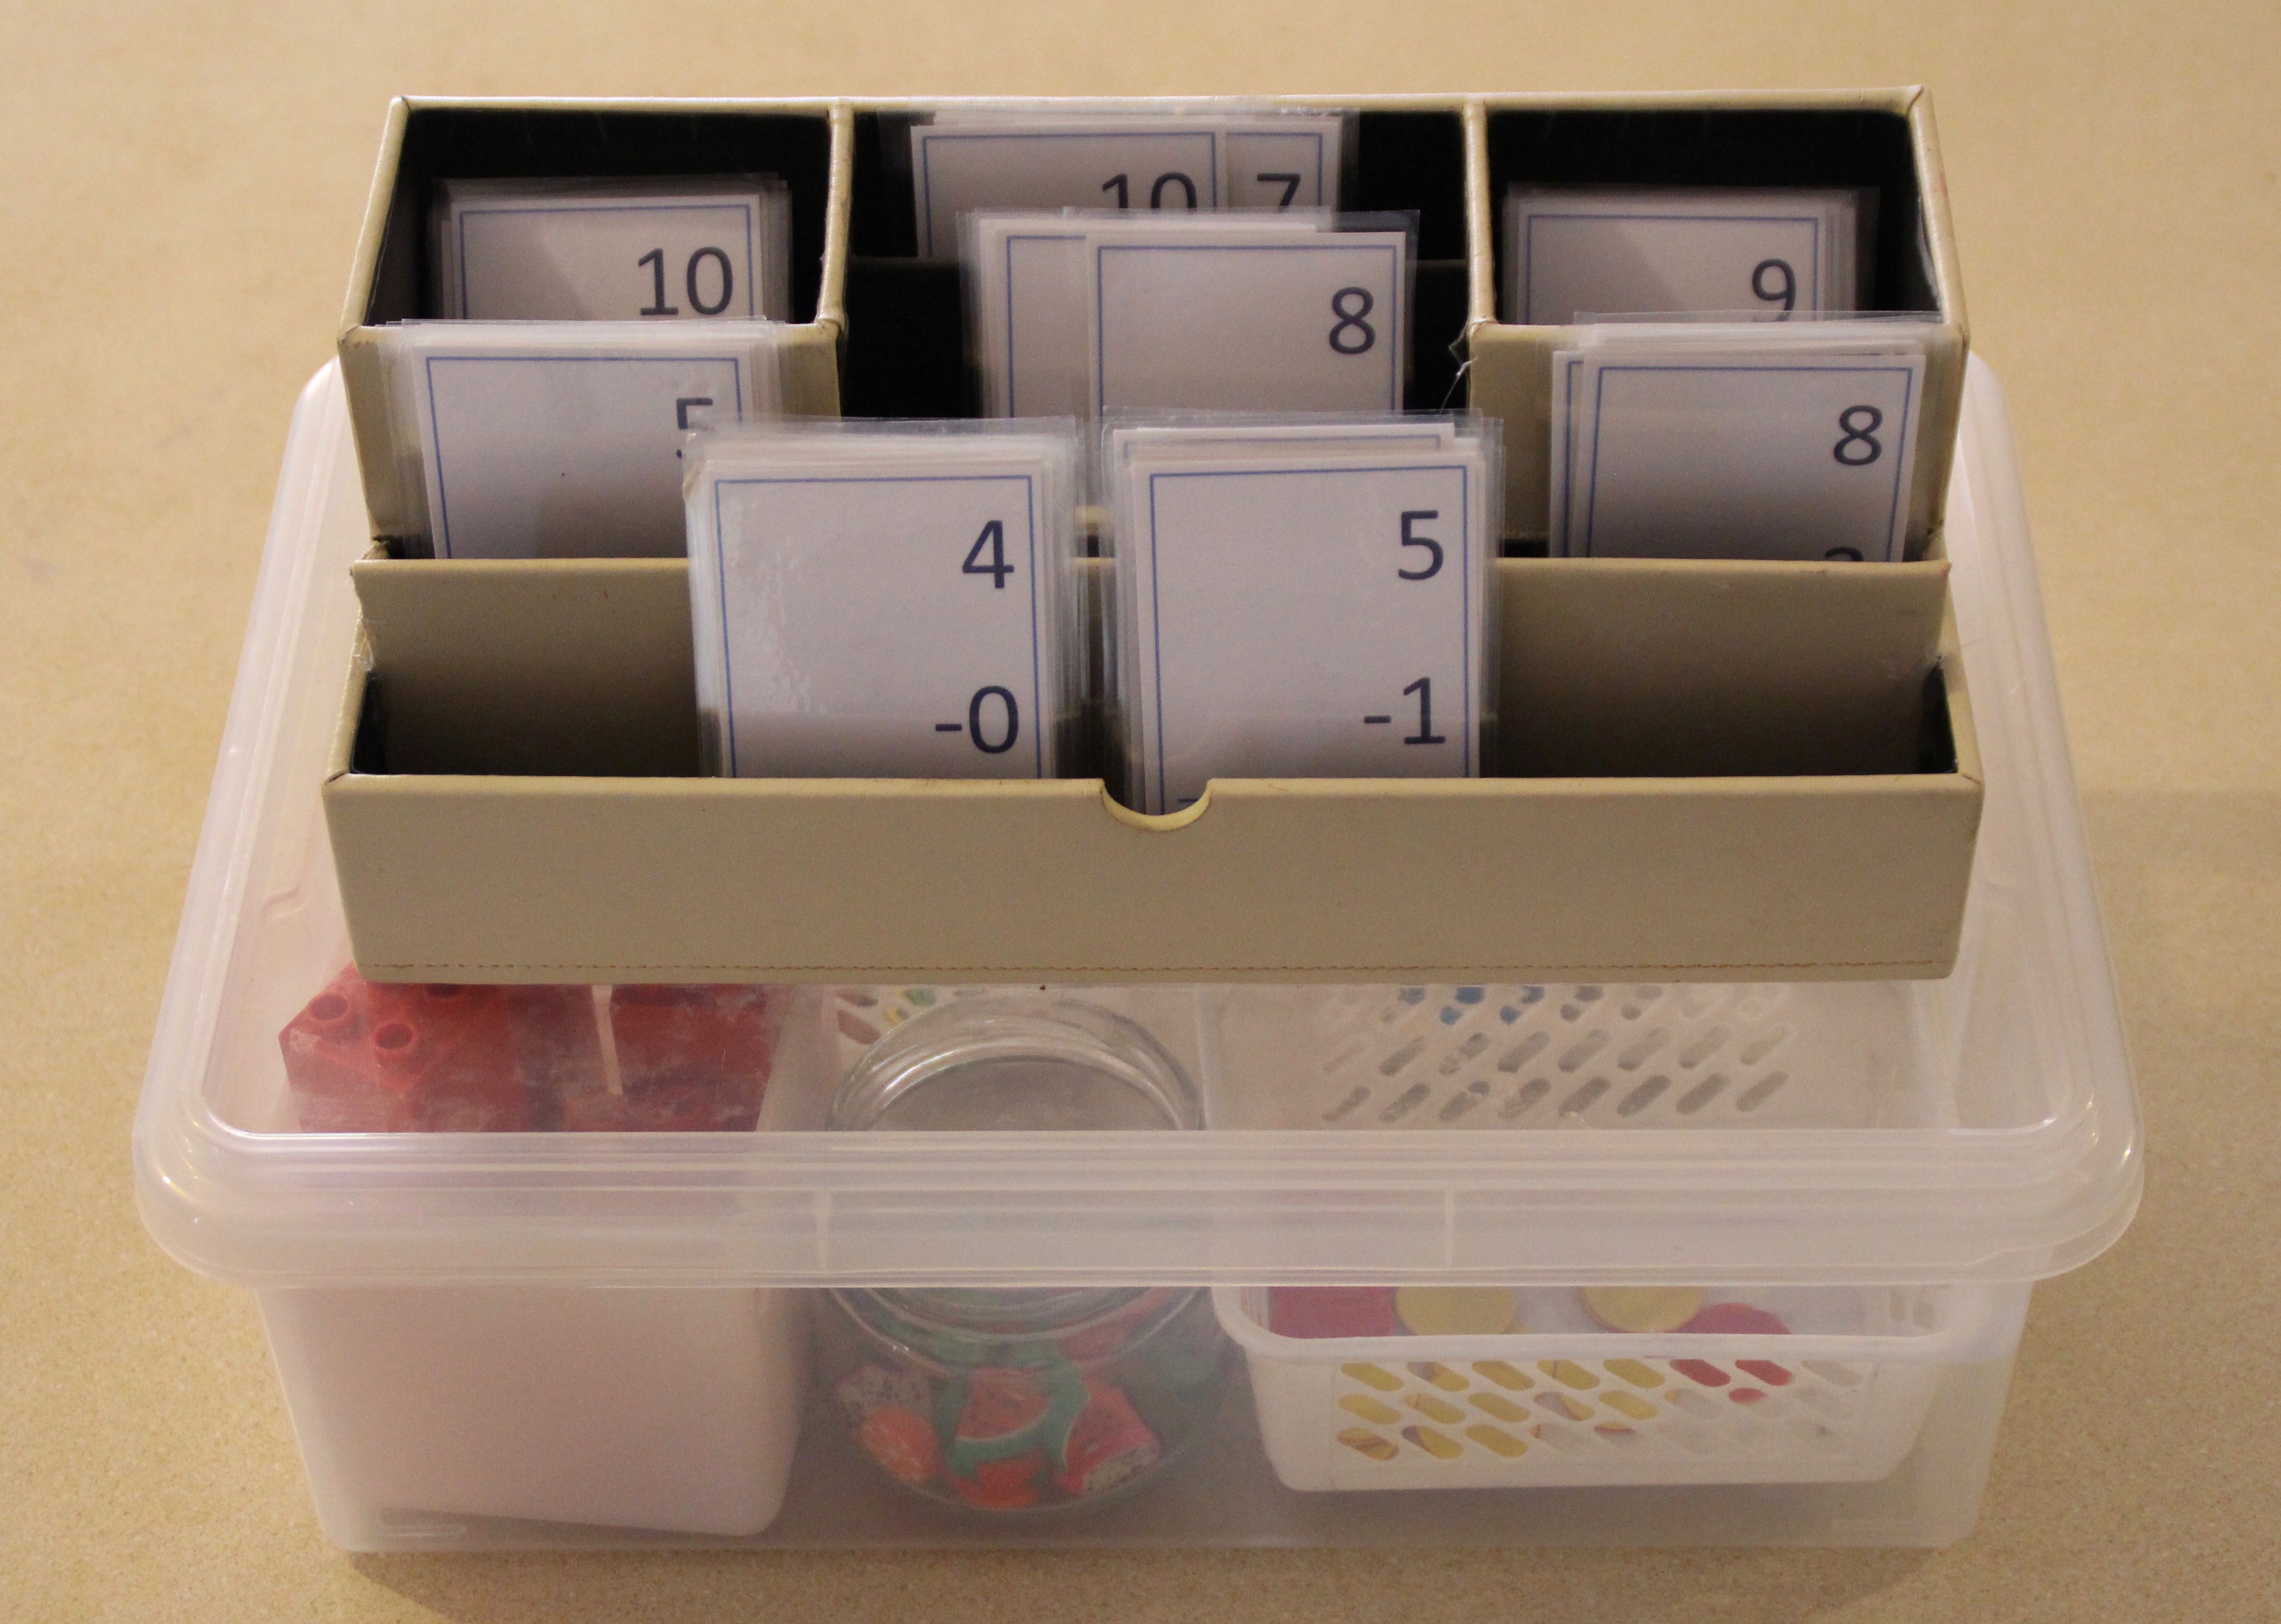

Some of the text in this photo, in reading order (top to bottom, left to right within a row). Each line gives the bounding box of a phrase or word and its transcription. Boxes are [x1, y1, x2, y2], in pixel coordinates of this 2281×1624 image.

[1102, 172, 1198, 208] 10
[1257, 173, 1301, 207] 7
[638, 247, 733, 317] 10
[1752, 259, 1796, 321] 9
[1329, 287, 1376, 355] 8
[1833, 405, 1883, 466] 8
[962, 520, 1015, 589] 4
[1398, 510, 1444, 581] 5
[935, 686, 1019, 754] -0
[1364, 677, 1446, 745] -1
